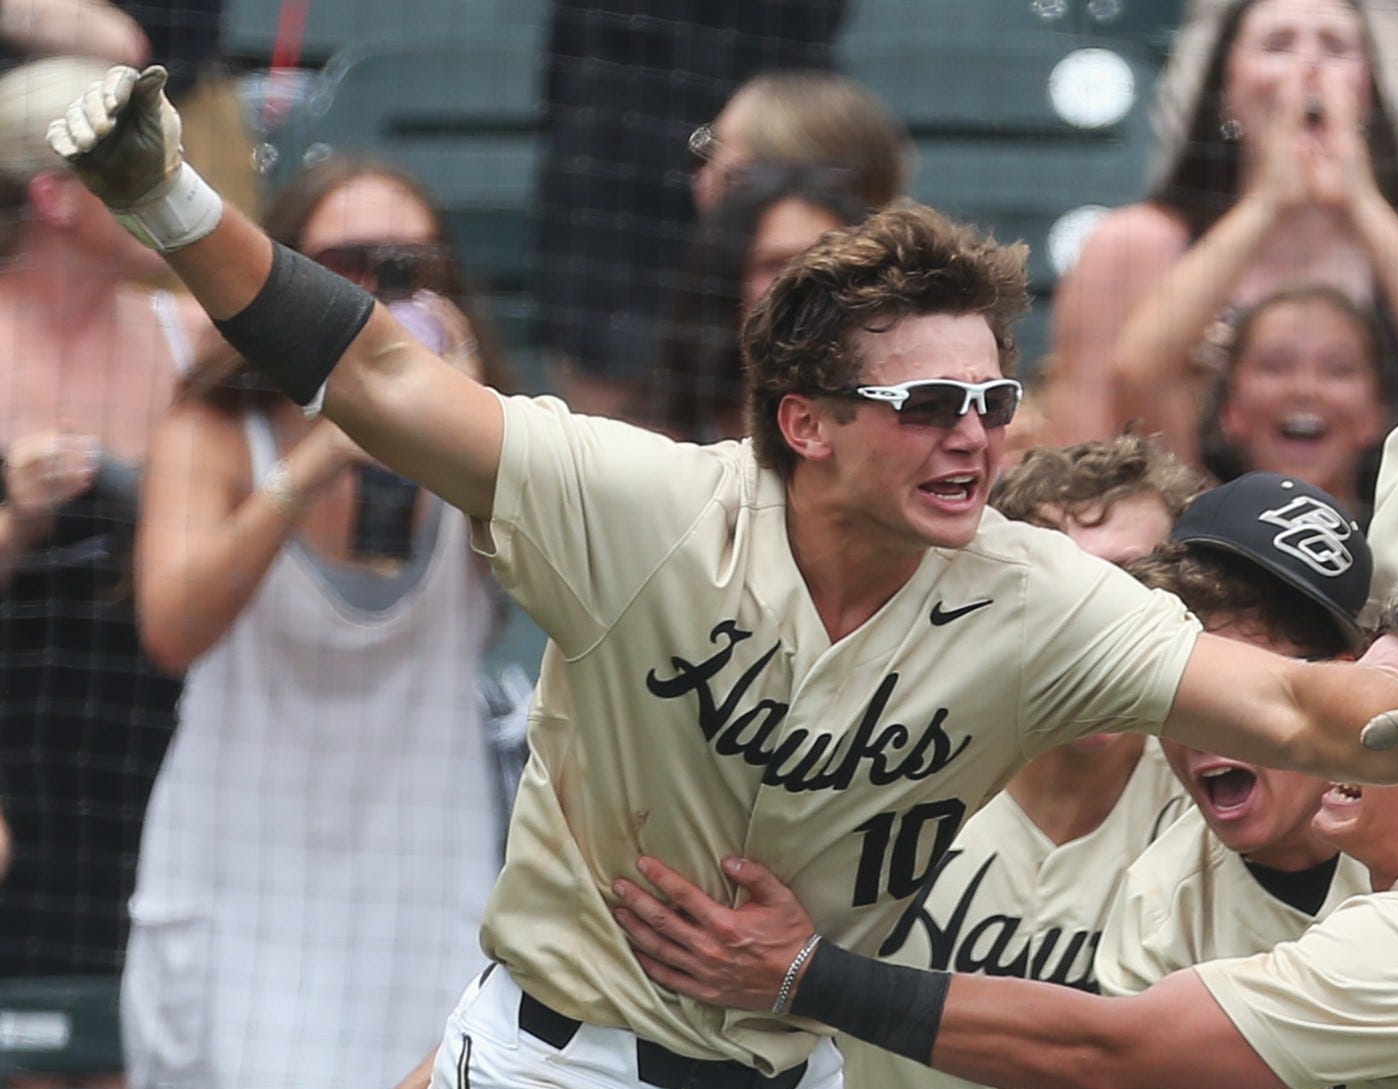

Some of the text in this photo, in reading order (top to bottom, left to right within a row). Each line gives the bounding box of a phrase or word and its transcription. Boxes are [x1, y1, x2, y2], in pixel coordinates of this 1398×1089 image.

[645, 619, 972, 793] Hawks
[852, 798, 966, 907] 10
[878, 849, 1102, 996] Haw
